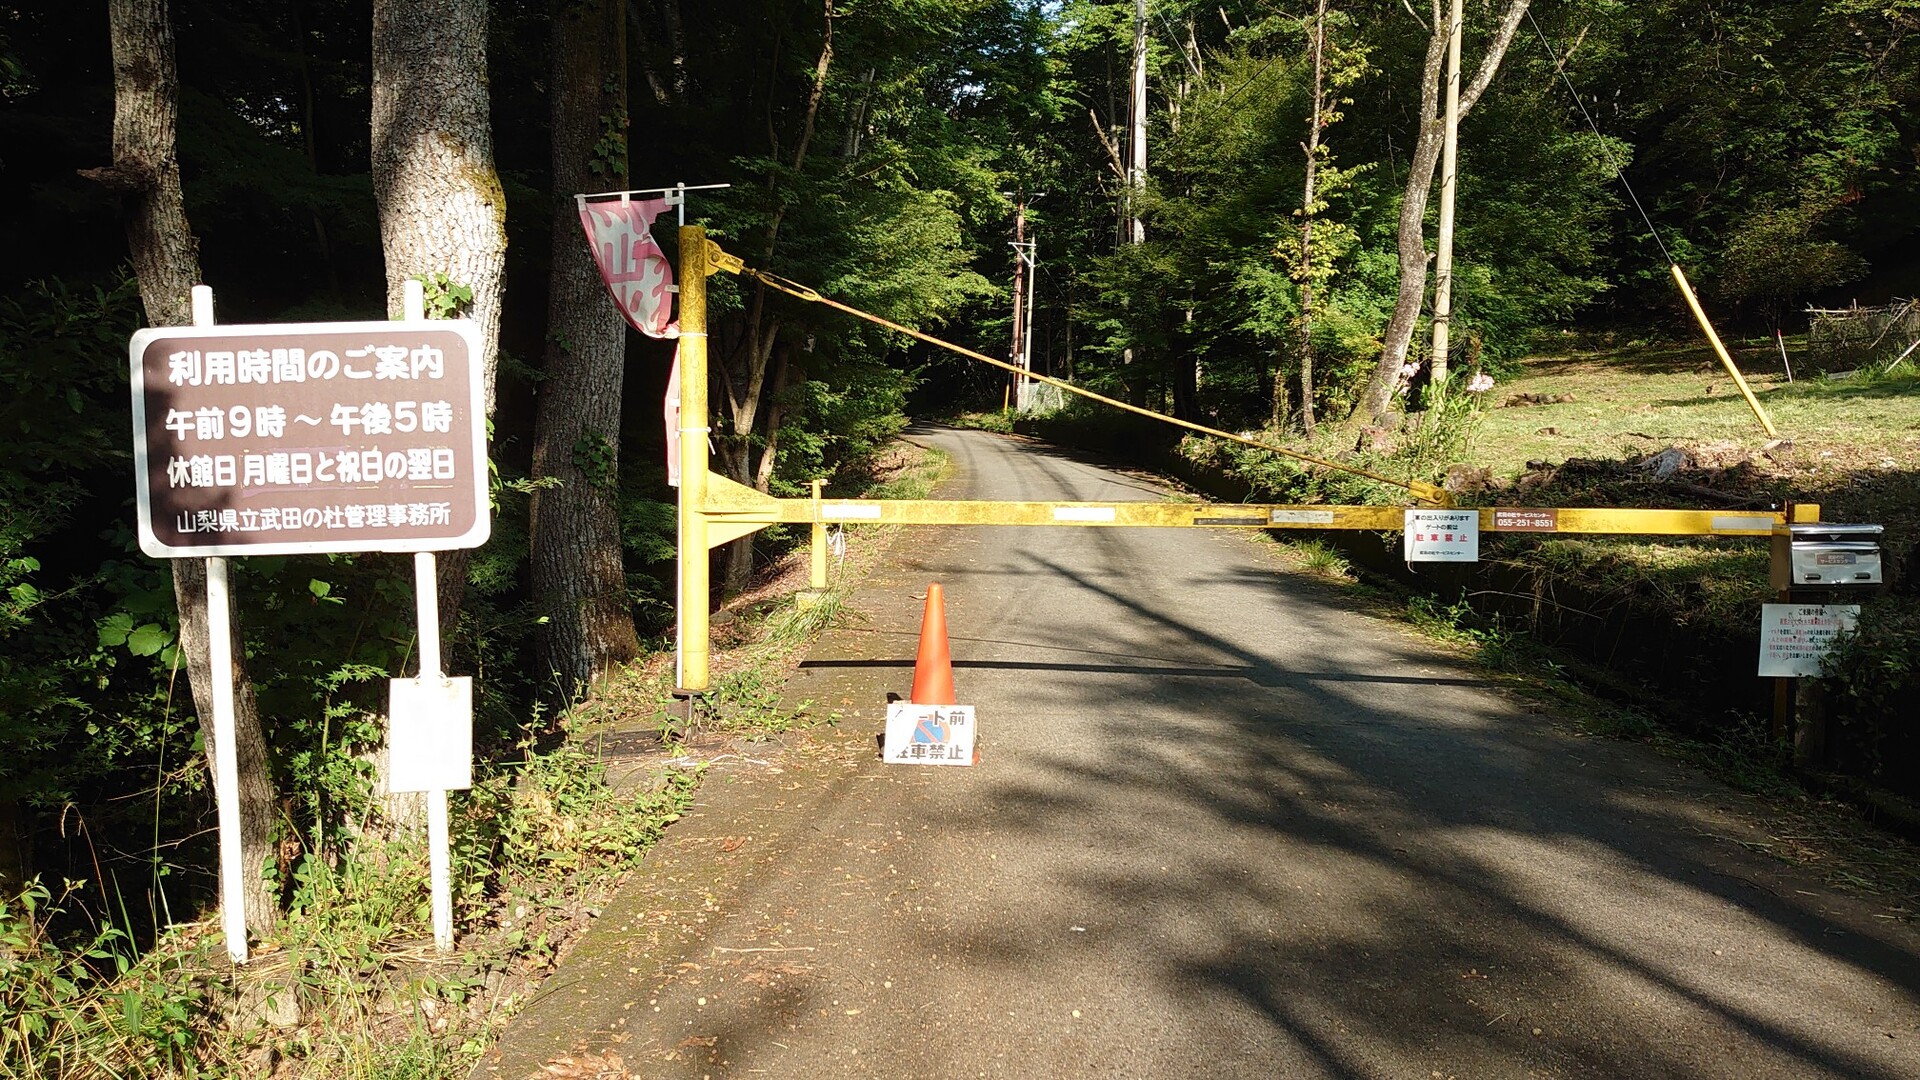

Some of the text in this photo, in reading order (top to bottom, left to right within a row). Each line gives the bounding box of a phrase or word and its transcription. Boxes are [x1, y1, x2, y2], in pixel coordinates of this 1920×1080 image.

[168, 345, 444, 386] 利用時間のご案内
[167, 448, 455, 488] 休館日 月曜日と祝日の翌日
[176, 502, 451, 534] 山梨県立武田の杜管理事務所
[1498, 518, 1553, 527] 055-251-8551
[895, 710, 965, 725] ート前
